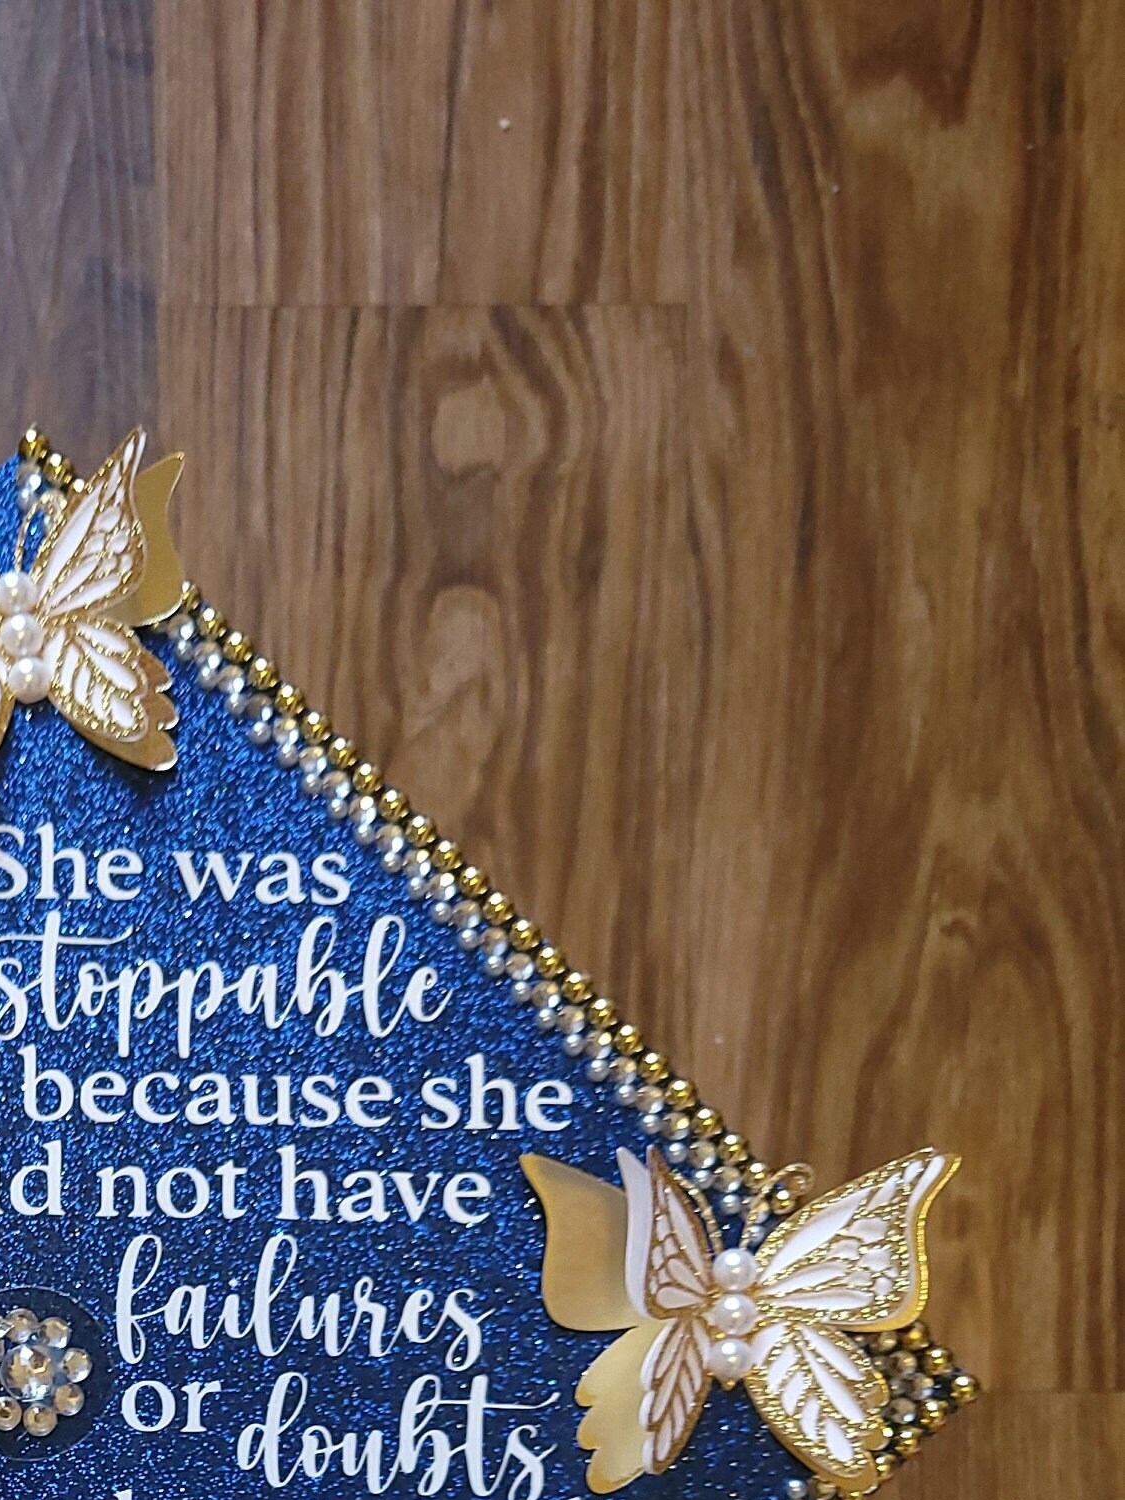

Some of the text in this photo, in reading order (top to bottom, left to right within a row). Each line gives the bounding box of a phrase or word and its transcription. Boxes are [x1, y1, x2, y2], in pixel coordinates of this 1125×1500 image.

[171, 850, 352, 904] was
[17, 1044, 393, 1128] because
[420, 1053, 573, 1132] she
[95, 1159, 248, 1220] not
[275, 1144, 491, 1225] have
[114, 1232, 495, 1371] failures
[120, 1380, 222, 1433] or
